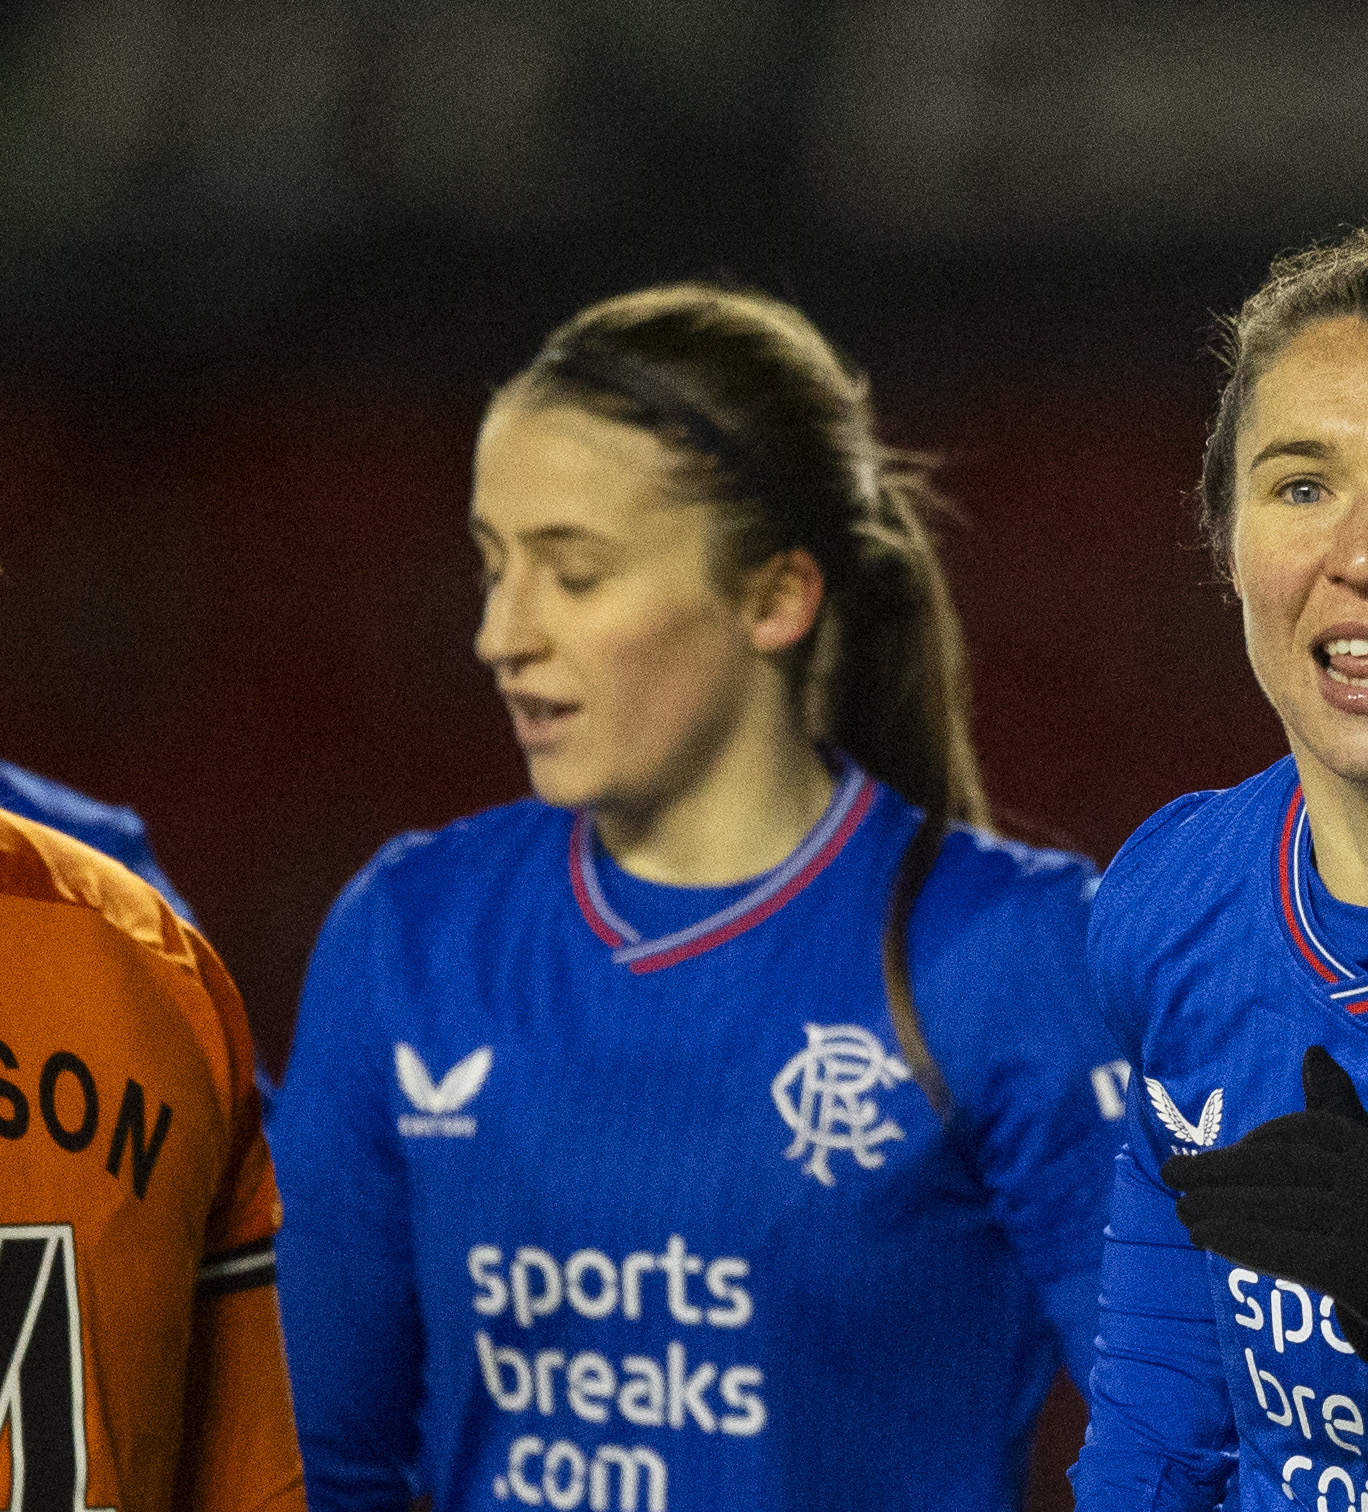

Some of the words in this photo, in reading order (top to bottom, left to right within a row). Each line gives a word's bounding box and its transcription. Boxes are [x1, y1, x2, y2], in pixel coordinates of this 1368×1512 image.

[467, 1233, 755, 1328] sports
[1228, 1267, 1356, 1354] spo
[474, 1330, 769, 1437] breaks
